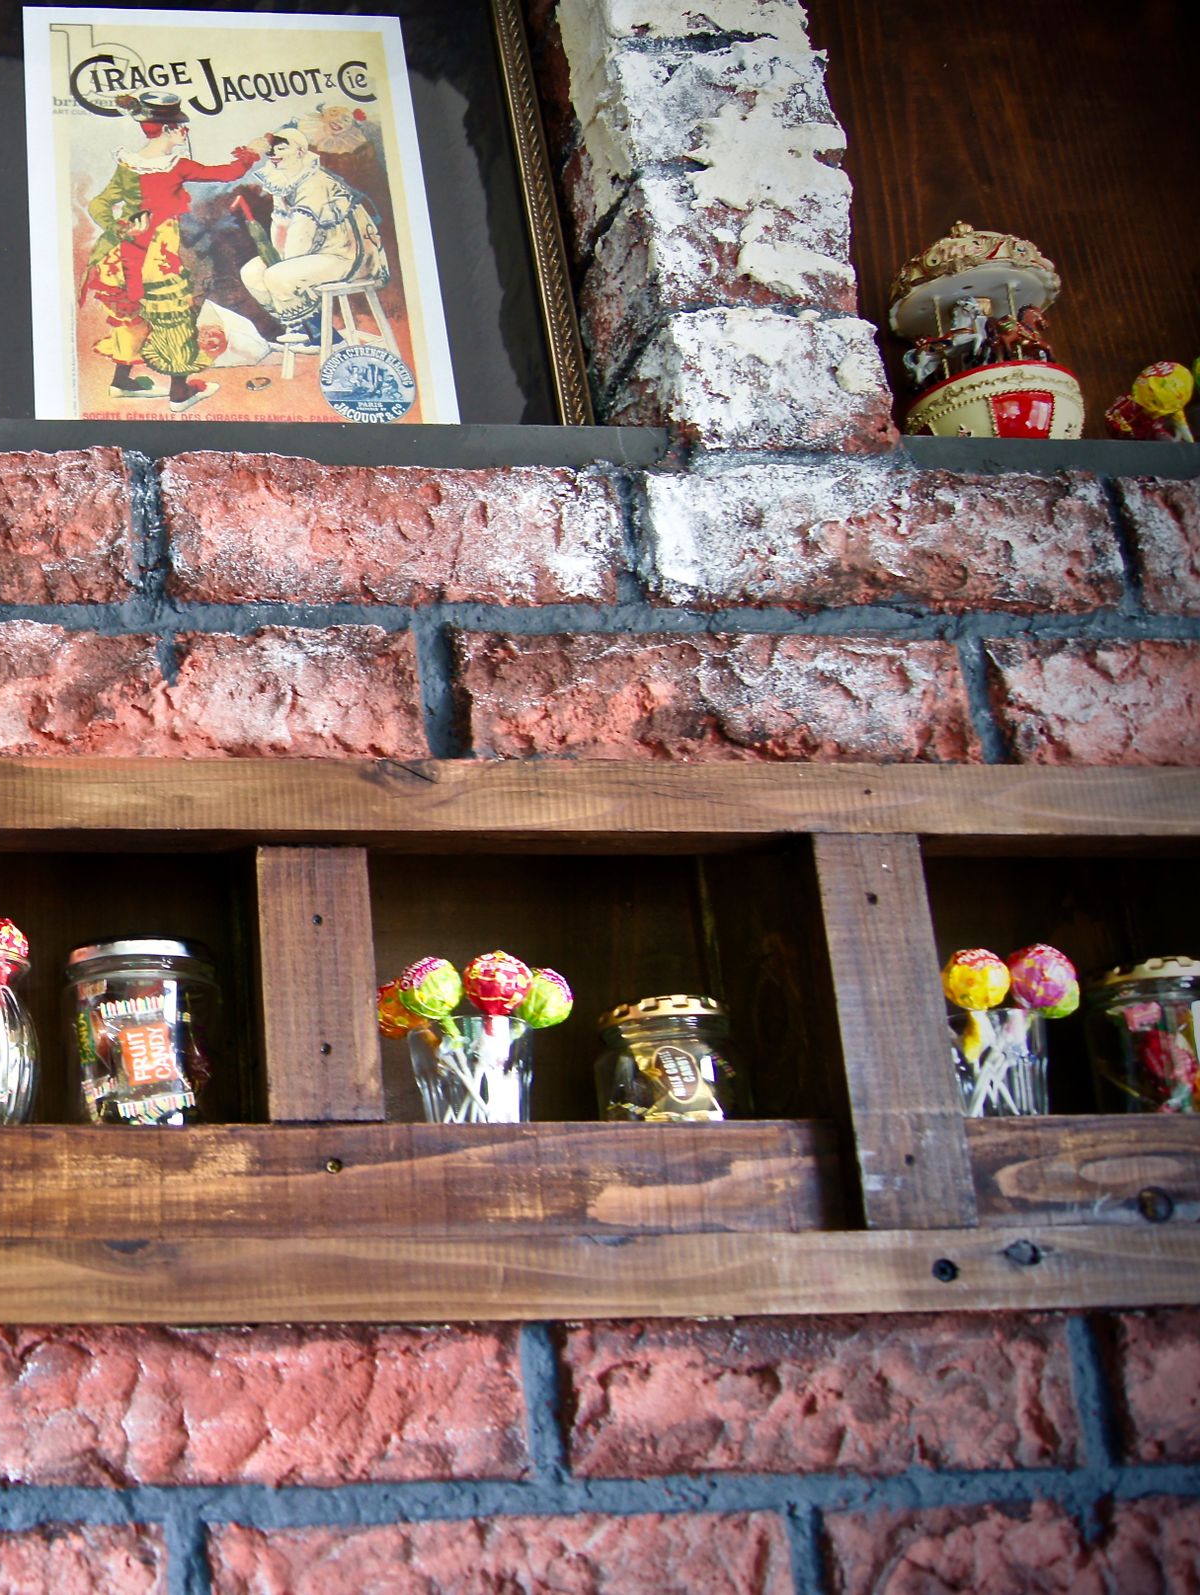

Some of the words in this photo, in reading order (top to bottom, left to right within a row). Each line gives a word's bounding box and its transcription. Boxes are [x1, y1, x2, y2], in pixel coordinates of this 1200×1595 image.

[69, 54, 193, 117] CIRAGE
[188, 57, 323, 116] JACQUOT
[127, 1031, 152, 1081] FRUIT
[147, 1027, 173, 1079] CANDY
